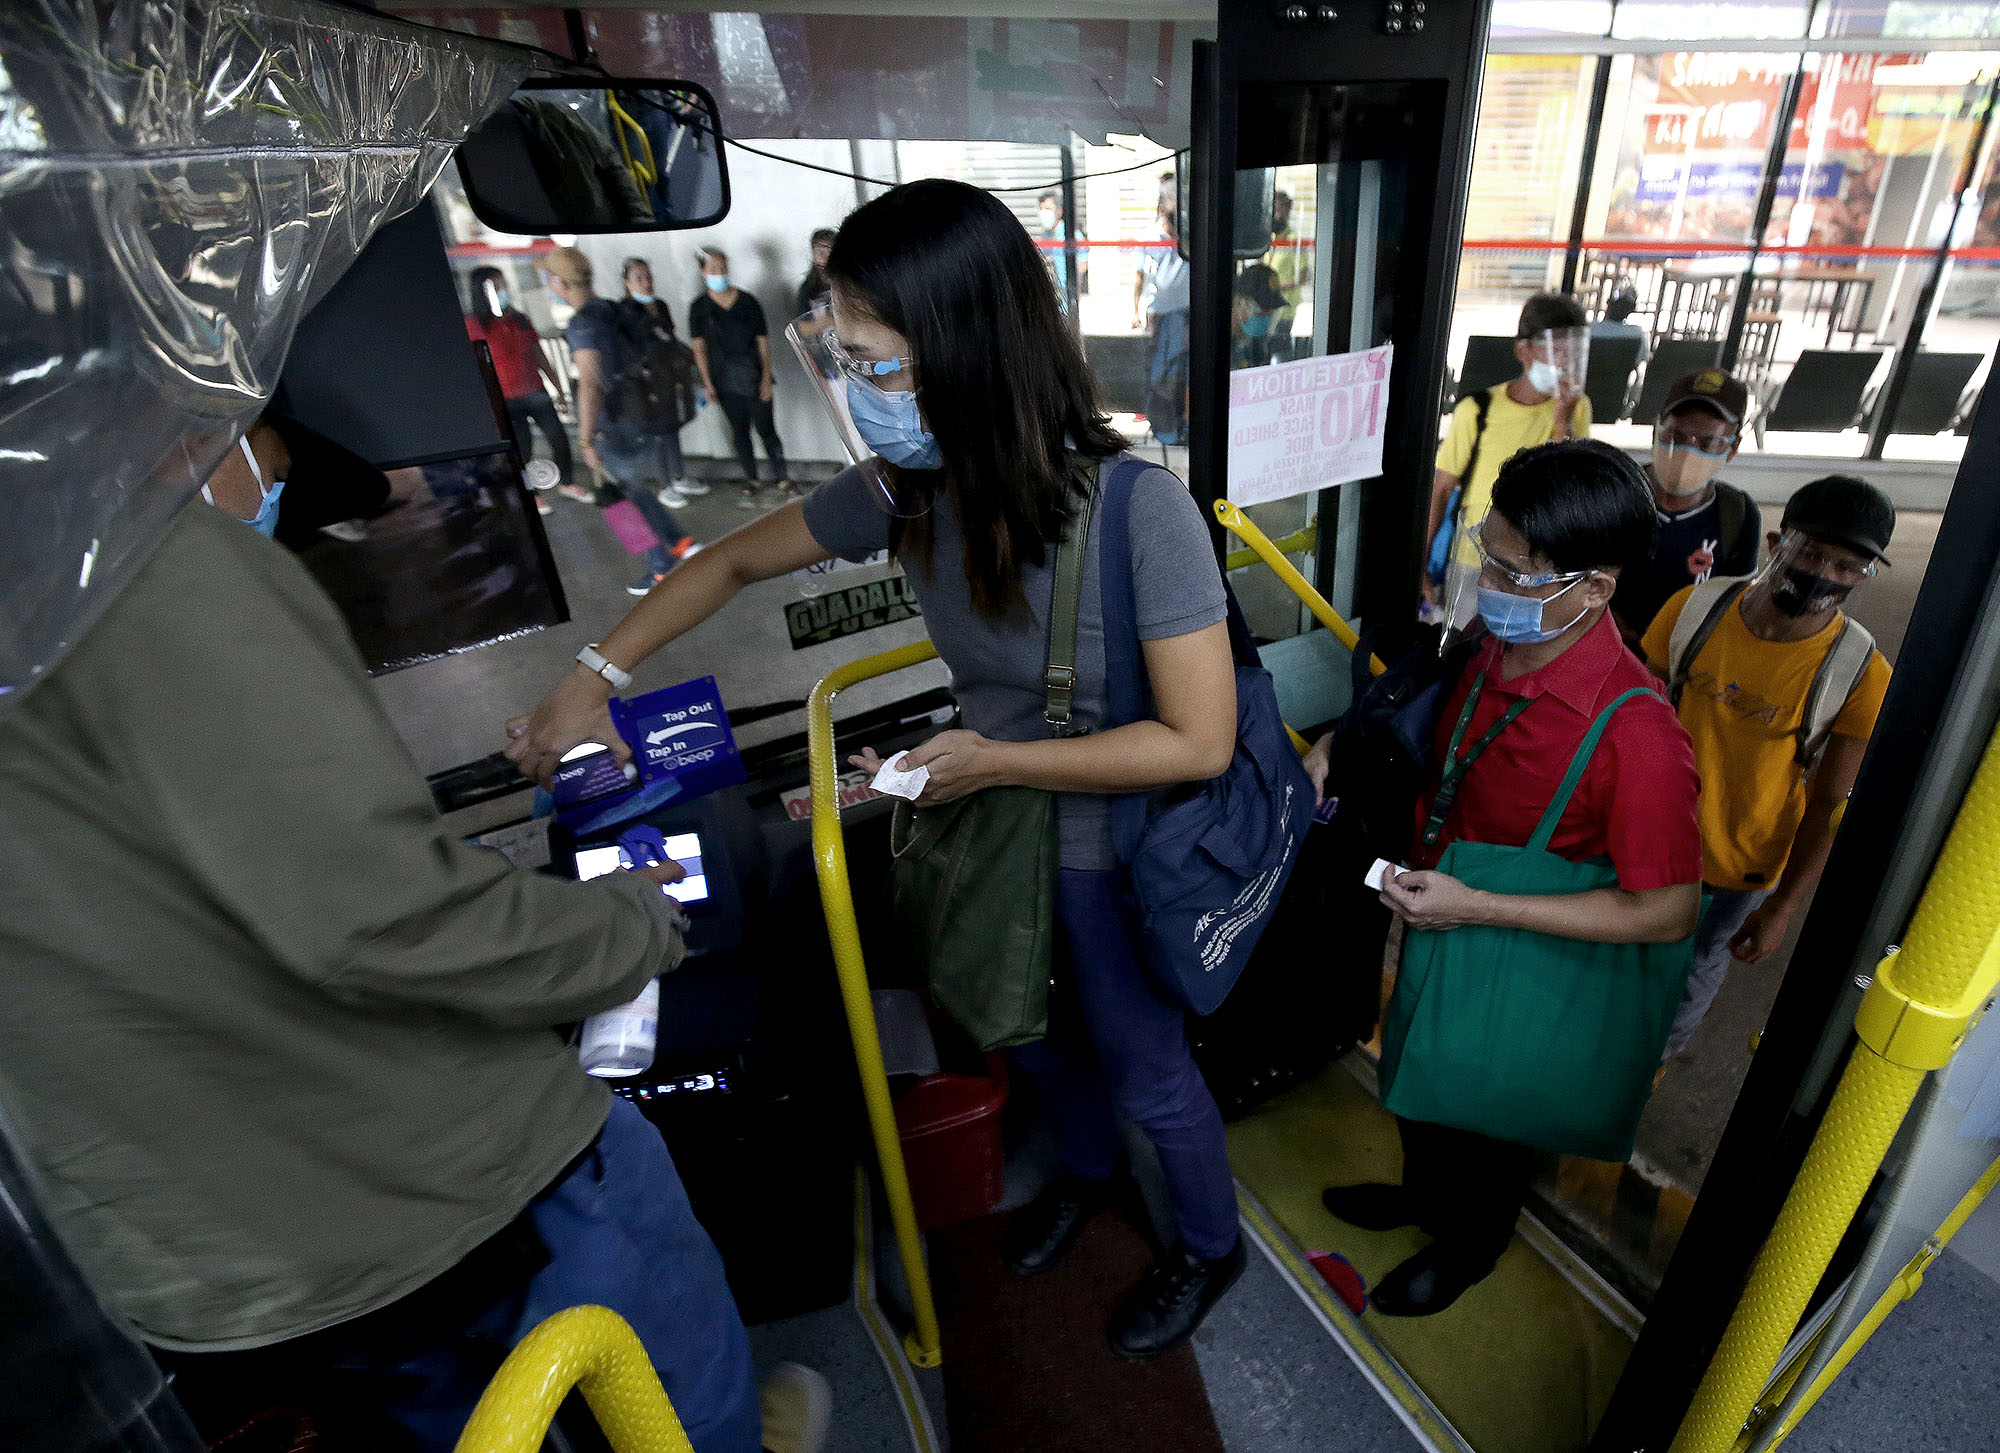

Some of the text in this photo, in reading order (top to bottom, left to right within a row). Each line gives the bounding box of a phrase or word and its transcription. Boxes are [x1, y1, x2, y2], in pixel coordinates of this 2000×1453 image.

[662, 702, 713, 723] Tap Out
[646, 741, 688, 759] Tap In
[678, 749, 716, 767] beep
[558, 766, 586, 781] beep
